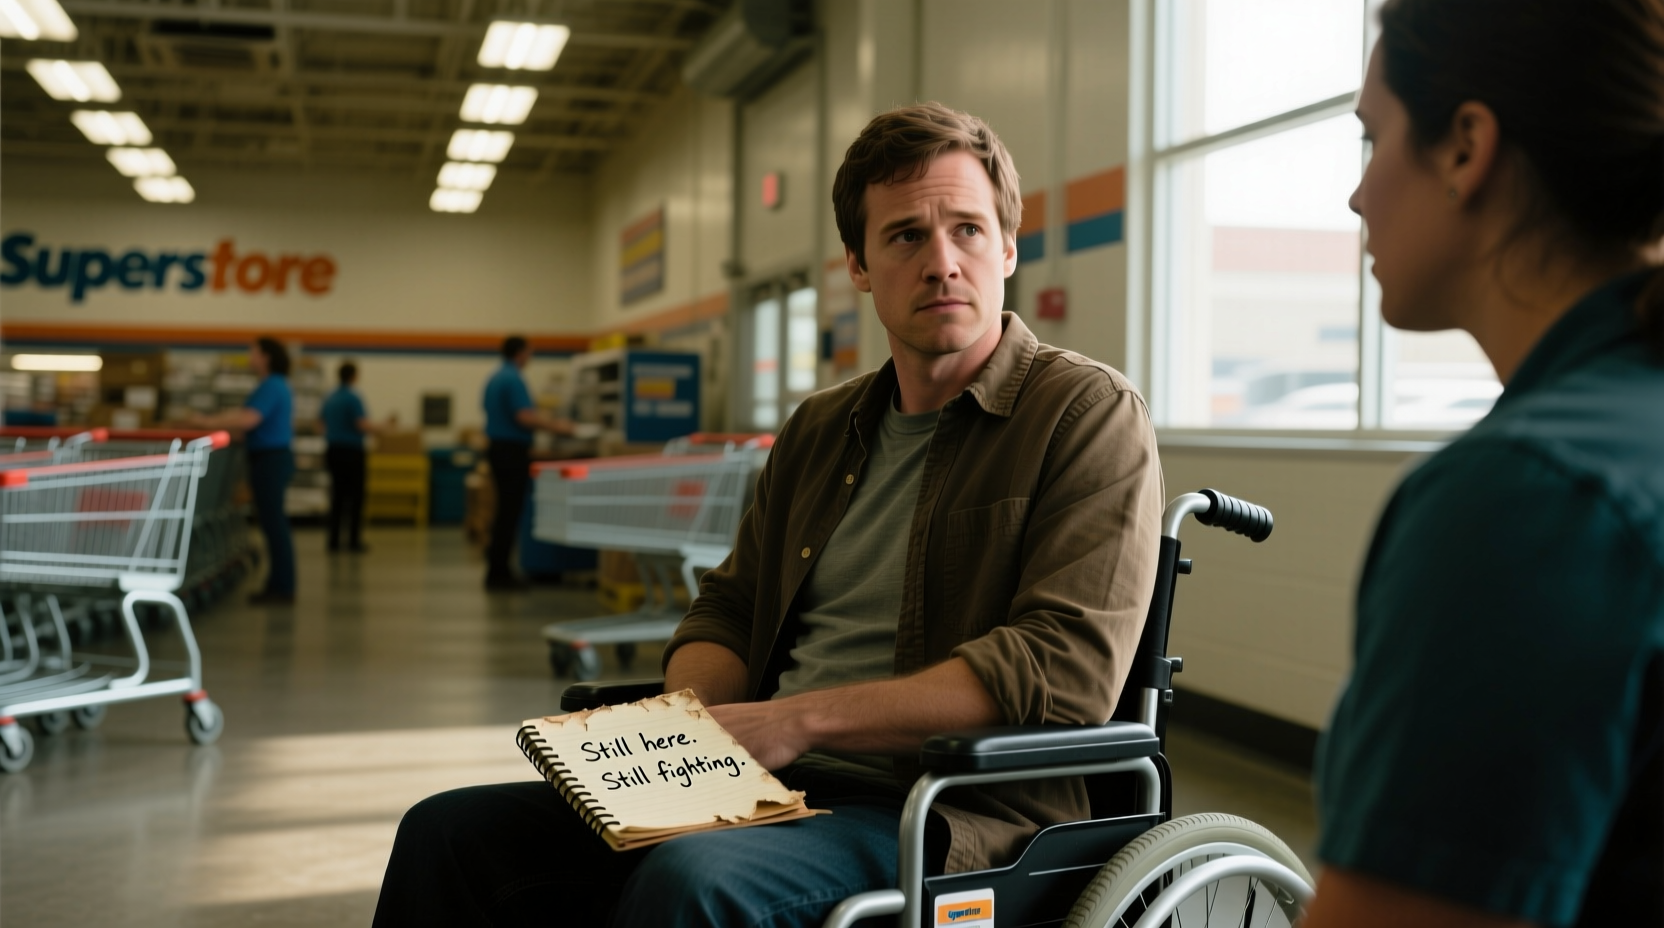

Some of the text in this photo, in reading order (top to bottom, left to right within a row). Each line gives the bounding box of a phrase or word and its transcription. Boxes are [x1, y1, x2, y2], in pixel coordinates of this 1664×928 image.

[0, 232, 336, 303] Superstore
[580, 732, 697, 762] Still here.
[601, 753, 746, 790] Still fighting.
